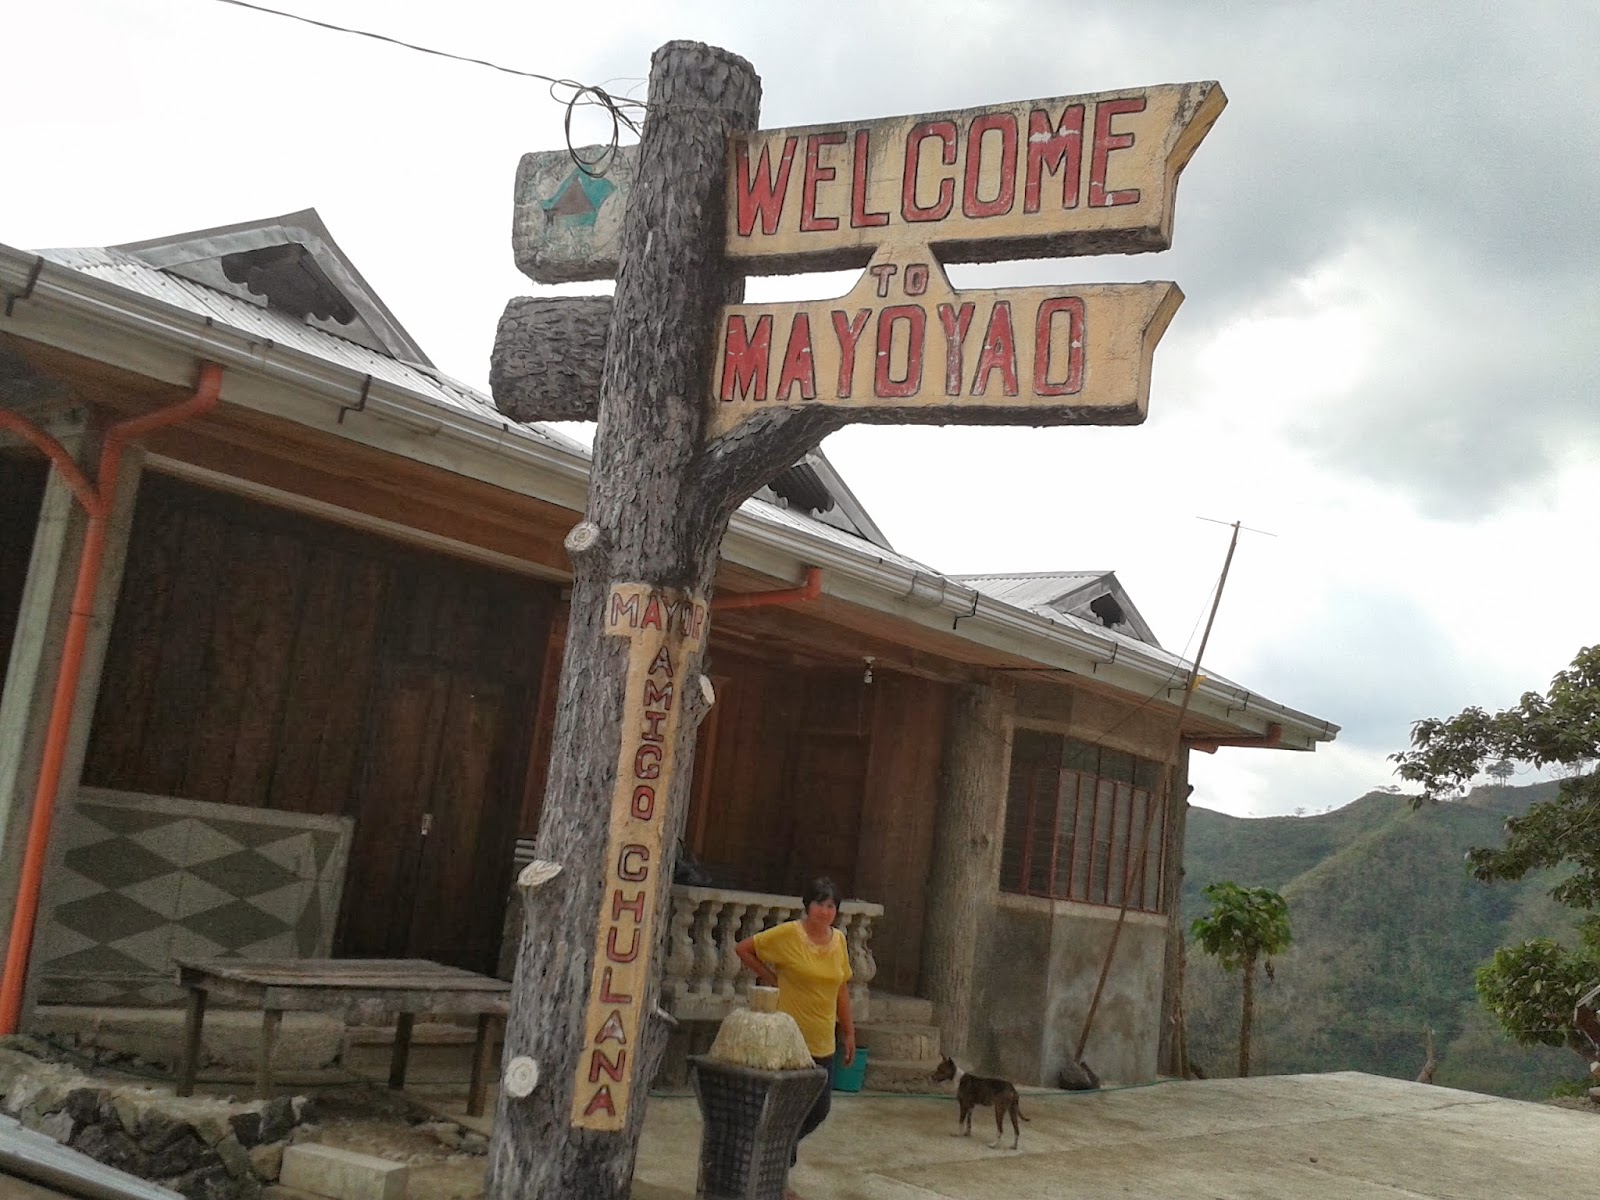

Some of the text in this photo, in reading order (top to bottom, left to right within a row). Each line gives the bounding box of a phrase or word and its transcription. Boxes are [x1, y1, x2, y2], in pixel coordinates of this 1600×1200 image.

[734, 98, 1147, 238] WELCOME
[870, 263, 930, 298] TO
[719, 296, 1085, 402] MAYOYAO
[610, 592, 705, 641] MAYOR
[583, 645, 674, 1117] AMIGO CHULANA
